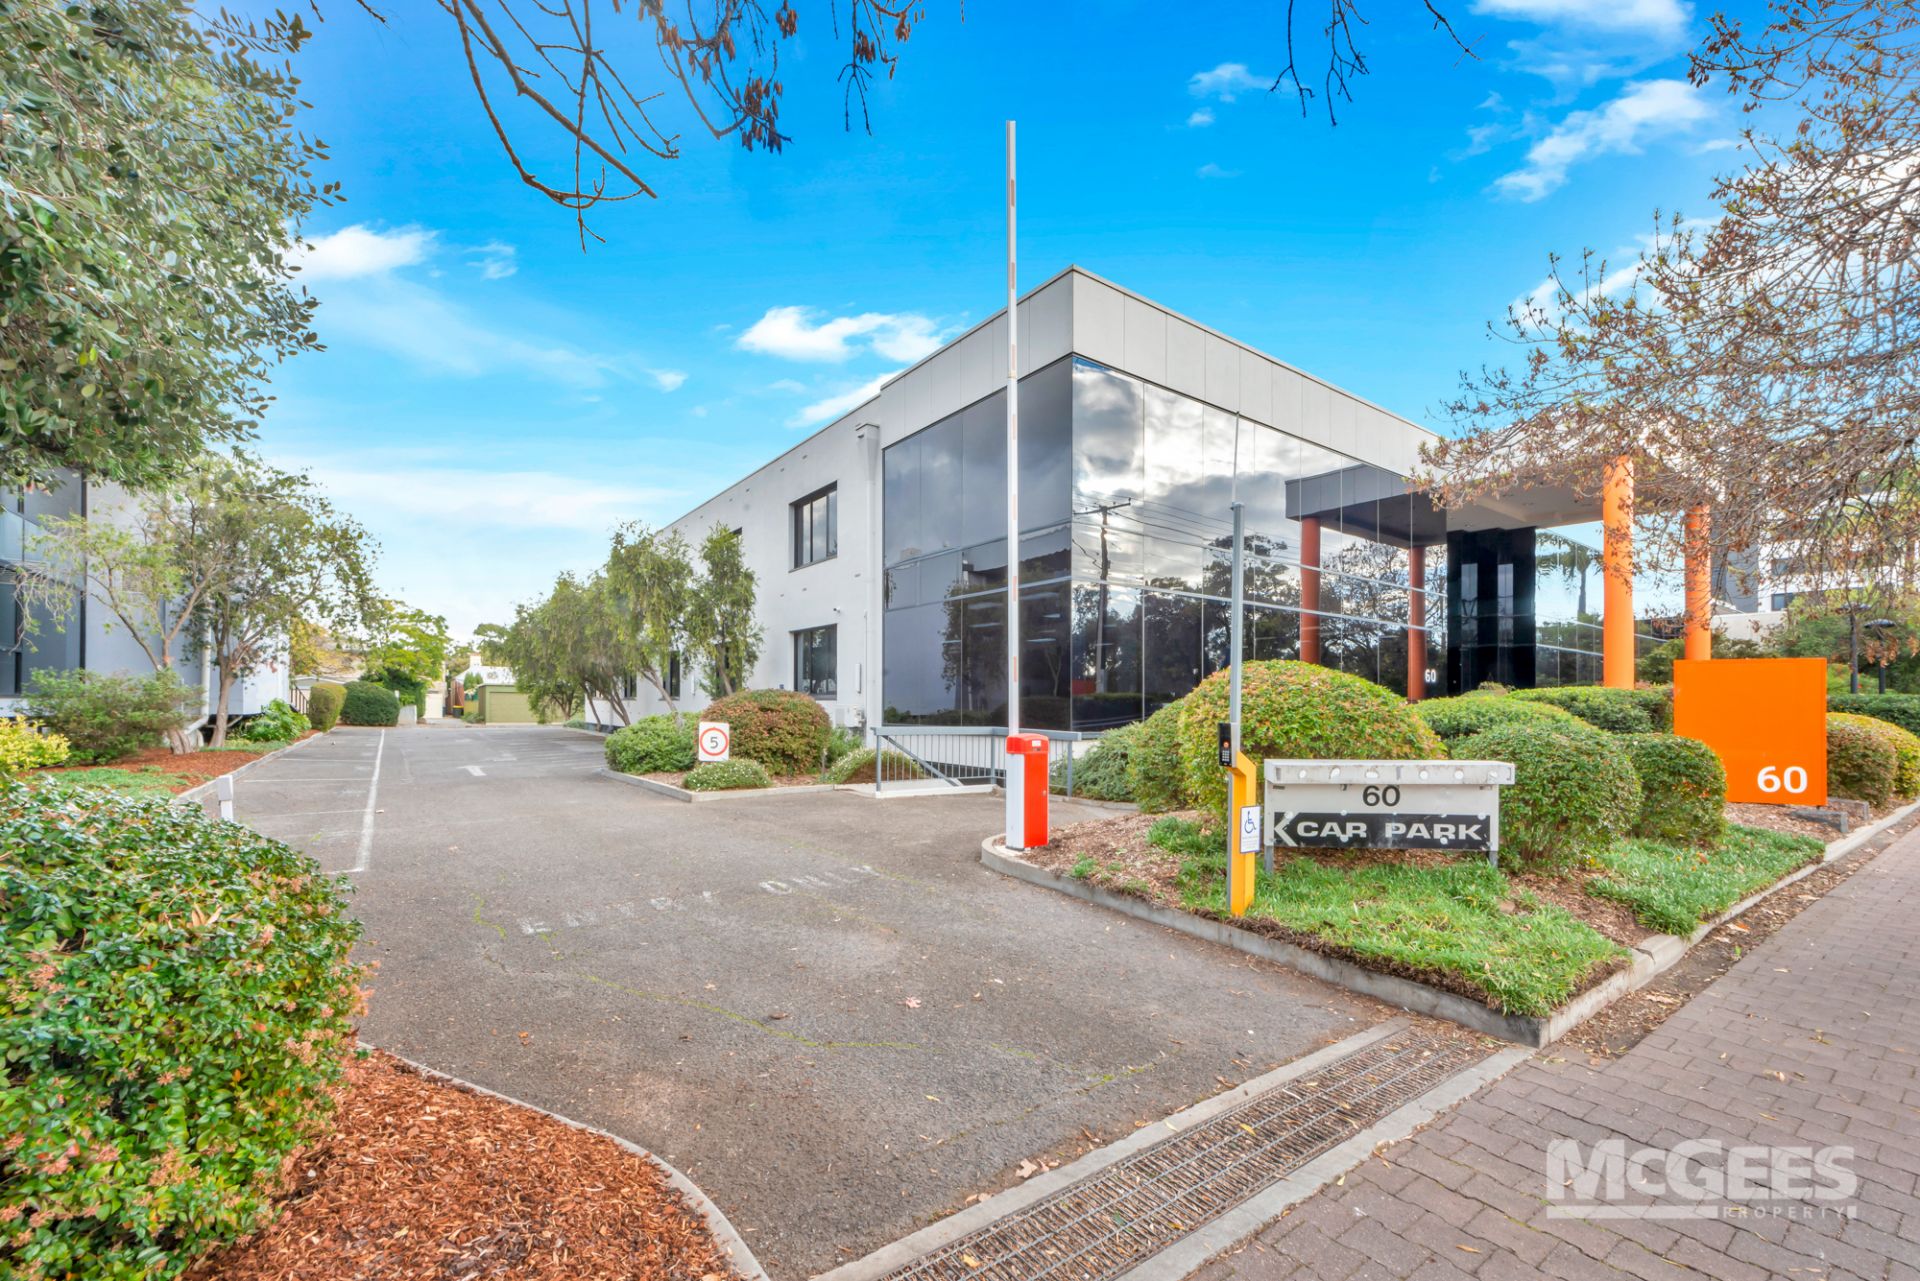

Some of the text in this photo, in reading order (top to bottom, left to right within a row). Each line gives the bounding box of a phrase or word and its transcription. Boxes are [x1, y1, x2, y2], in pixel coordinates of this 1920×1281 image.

[1424, 668, 1436, 683] 60
[710, 736, 719, 749] 5
[1757, 765, 1808, 794] 60
[1362, 785, 1401, 807] 60
[1296, 821, 1482, 841] CAR PARK
